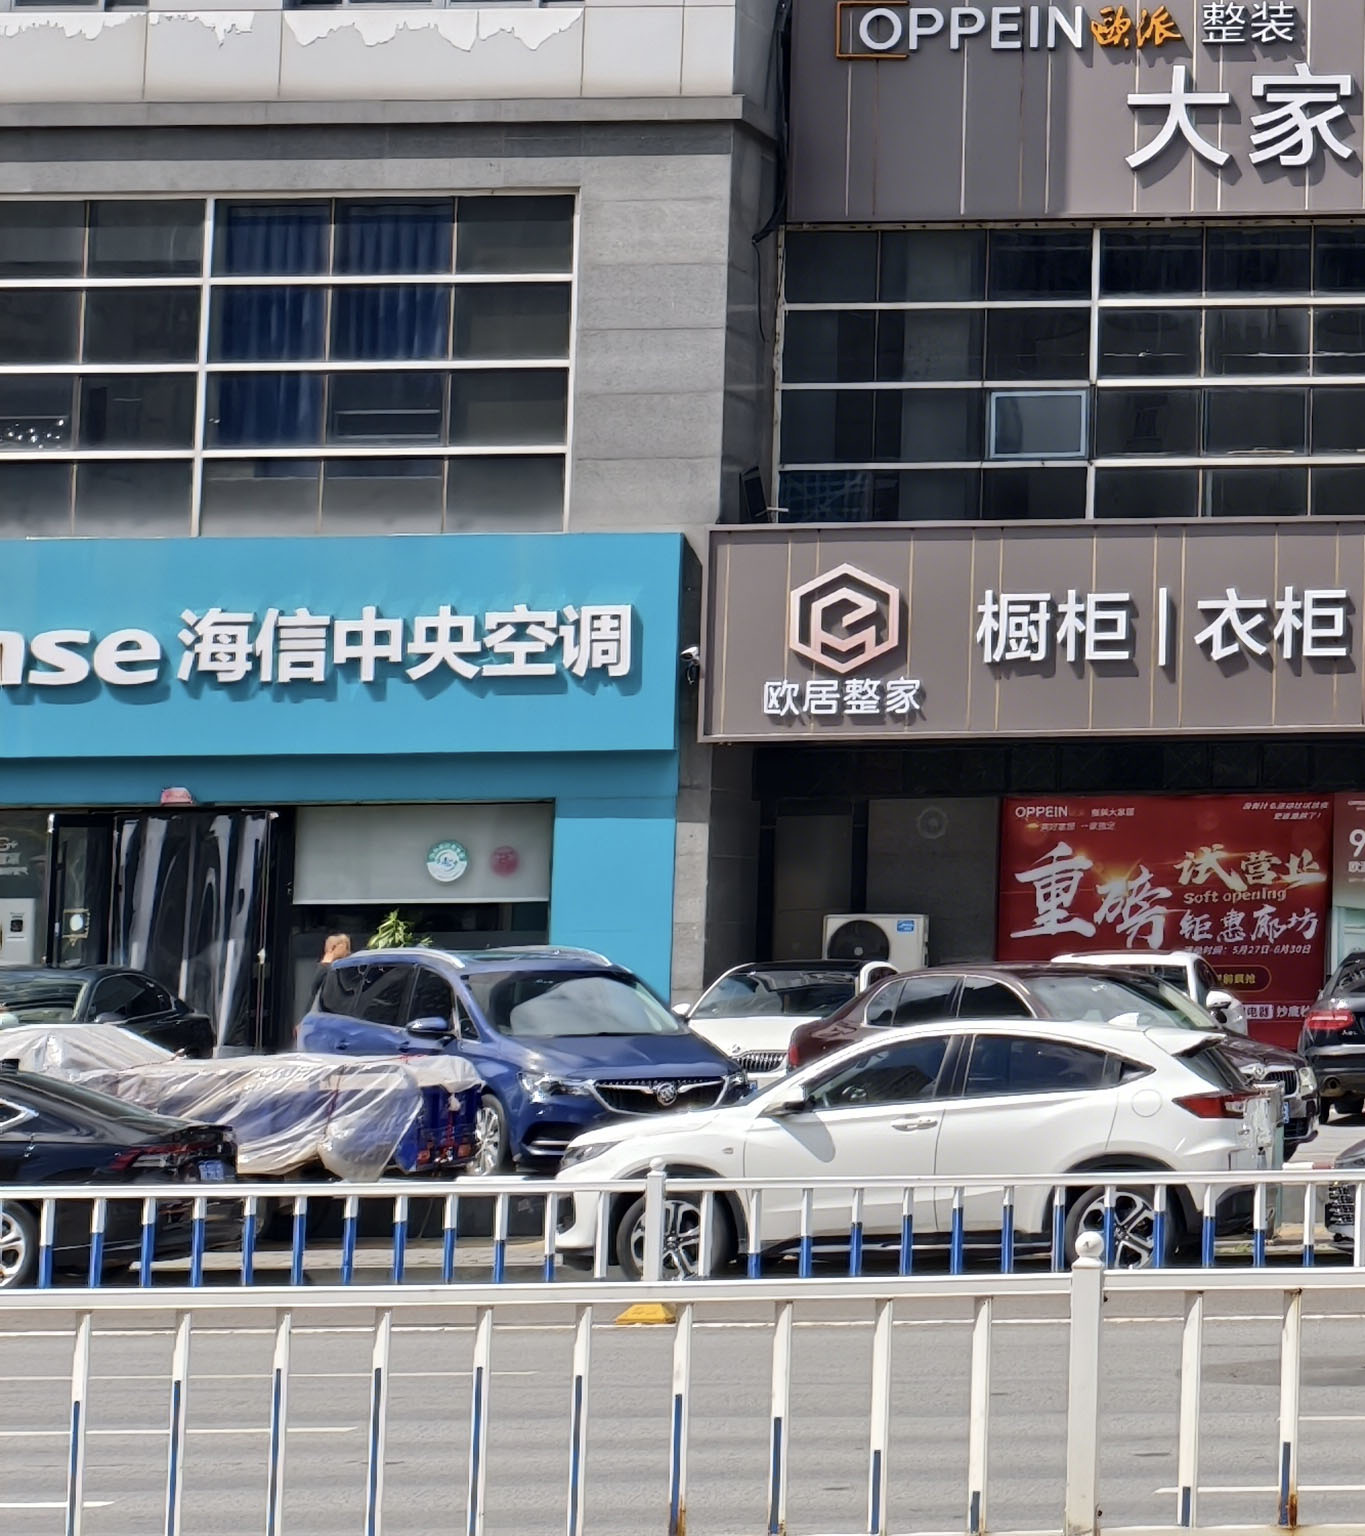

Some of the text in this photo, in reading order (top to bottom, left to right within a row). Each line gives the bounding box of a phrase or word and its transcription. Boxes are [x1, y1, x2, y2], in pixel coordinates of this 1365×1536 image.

[859, 4, 1084, 50] OPPEIN
[1201, 0, 1295, 43] 整装
[177, 602, 634, 684] 海信中央空调
[976, 588, 1131, 663] 橱柜
[1194, 585, 1349, 661] 衣柜
[763, 676, 922, 717] 欧居整家
[1015, 805, 1069, 818] OPPEIN
[1173, 843, 1328, 893] 试营业
[1010, 840, 1174, 950] 重磅
[1184, 887, 1288, 905] Soft opening
[1179, 904, 1319, 945] 钜惠廊坊
